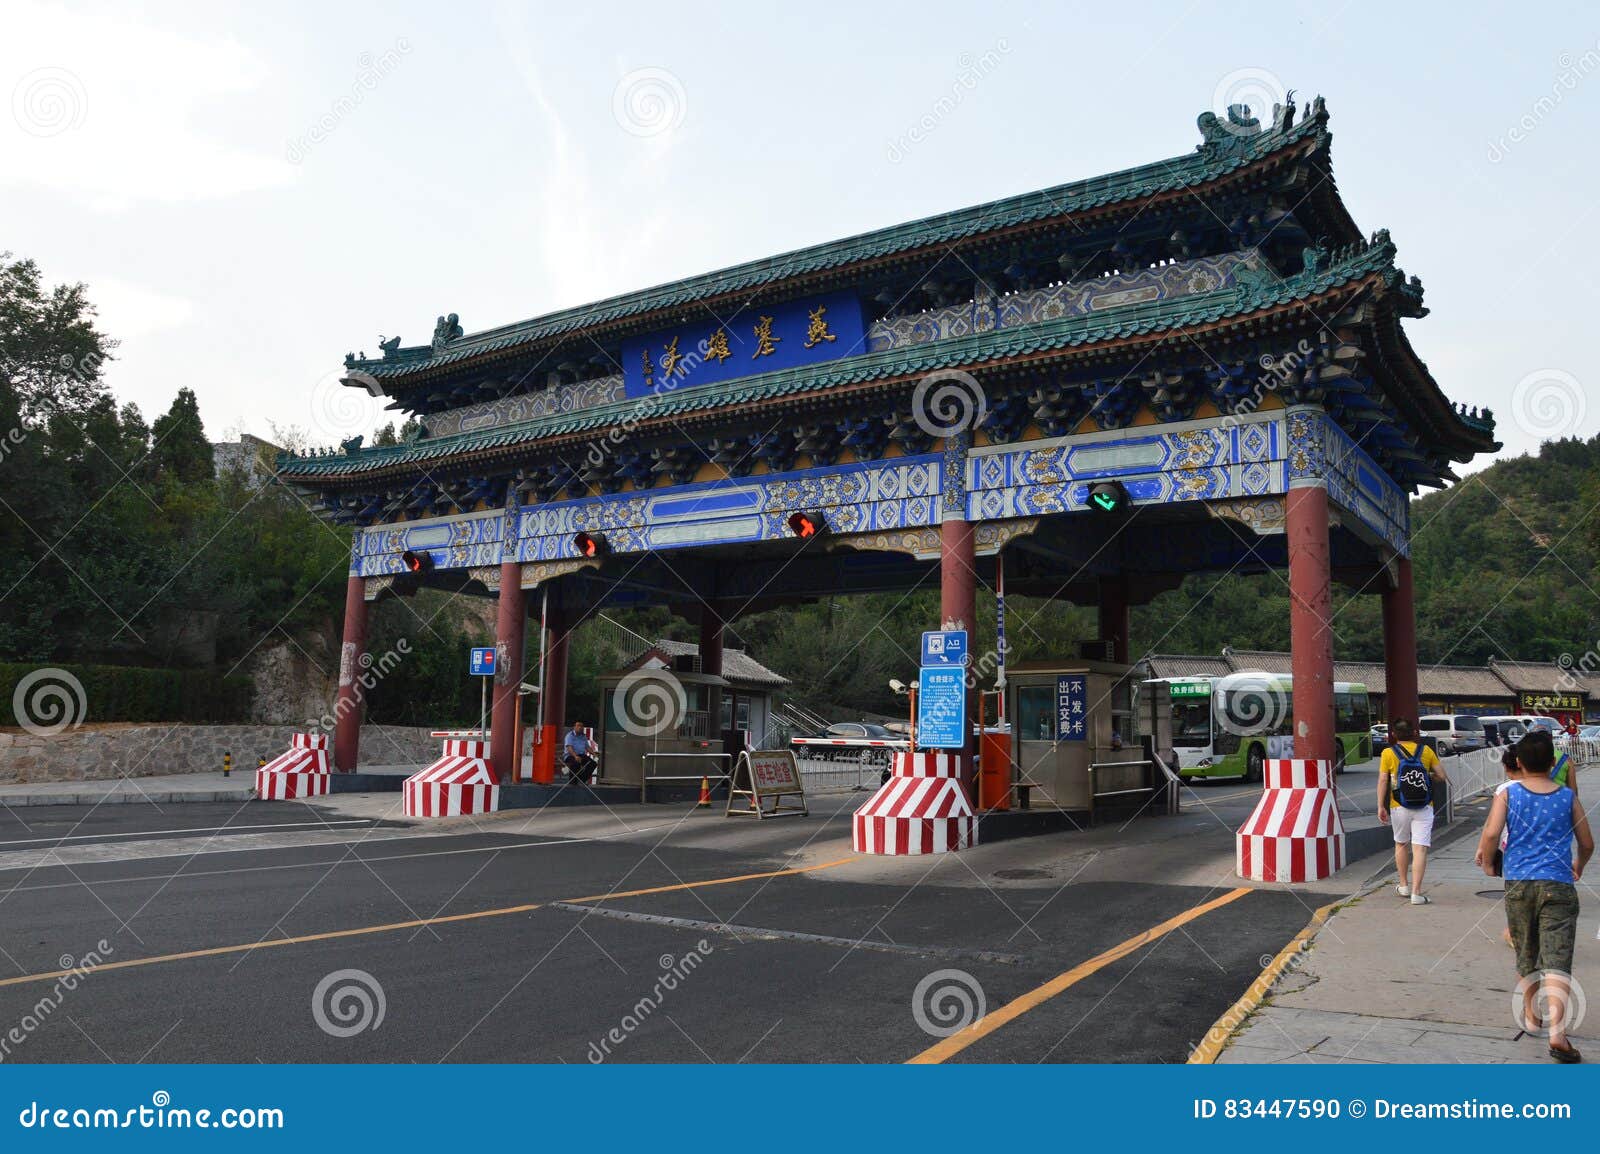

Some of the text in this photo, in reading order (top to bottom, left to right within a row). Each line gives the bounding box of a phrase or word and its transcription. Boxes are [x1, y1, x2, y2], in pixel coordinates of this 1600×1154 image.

[947, 639, 960, 647] 入口
[1059, 681, 1070, 734] 出口交费
[1071, 681, 1083, 734] 不发卡
